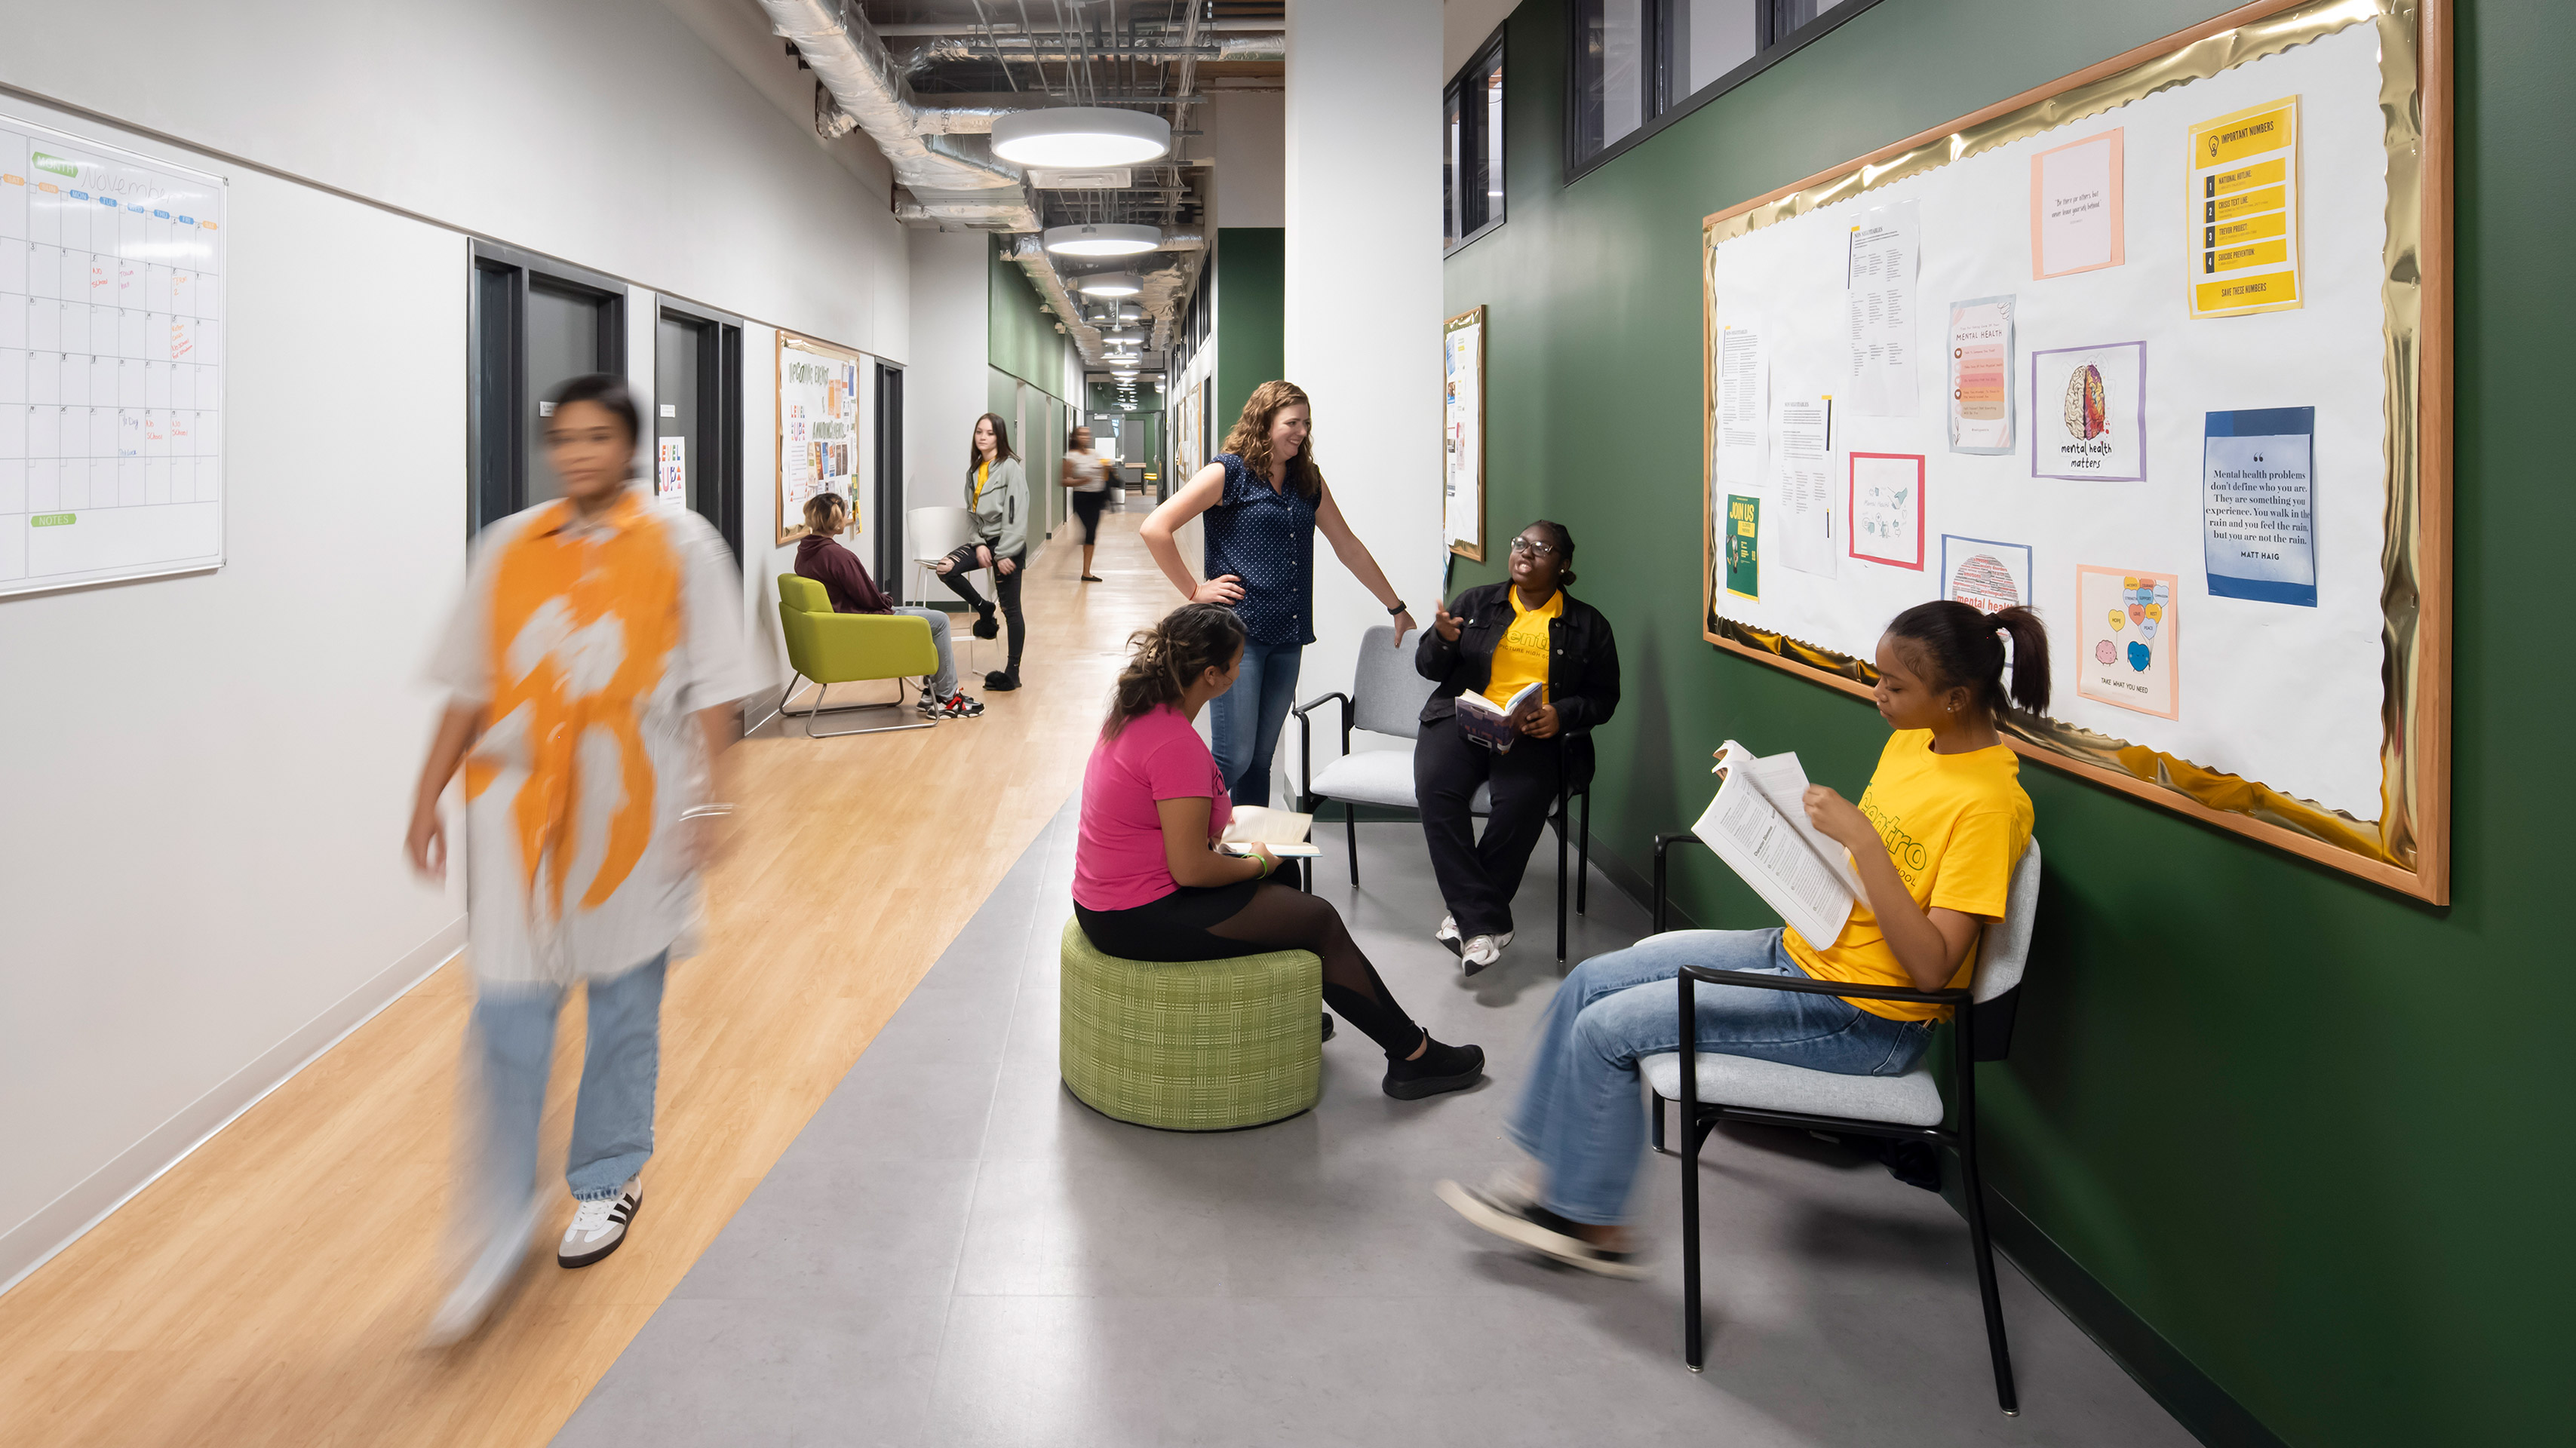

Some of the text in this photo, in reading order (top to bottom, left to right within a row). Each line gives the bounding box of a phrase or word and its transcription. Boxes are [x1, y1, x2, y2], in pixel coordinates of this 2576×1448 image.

[2221, 121, 2274, 144] IMPORTANT NUMBERS
[37, 155, 74, 174] MONTH
[2218, 174, 2237, 184] NATIONAL
[2209, 182, 2212, 191] 1
[72, 191, 87, 200] MON
[102, 198, 115, 206] TUE
[128, 204, 142, 213] WED
[156, 210, 167, 219] THU
[2218, 200, 2231, 209] CRISIS
[2231, 198, 2240, 206] TEXT
[2209, 207, 2212, 216] 2
[2219, 226, 2233, 235] TREVOR
[2209, 232, 2212, 241] 3
[2208, 257, 2212, 266] 4
[2218, 252, 2233, 261] SUICIDE
[2221, 282, 2267, 297] SAVE THESE NUMBERS
[1956, 330, 2003, 341] MENTAL HEALTH
[789, 361, 829, 387] UPCOMING EVENTS
[791, 405, 805, 419] LEVEL
[659, 444, 680, 462] EVEL
[2061, 440, 2112, 456] mental health
[2071, 457, 2101, 468] matters
[2214, 470, 2306, 480] Mental health problems
[2210, 482, 2231, 490] don't
[2233, 482, 2257, 491] define
[2259, 483, 2276, 492] who
[2277, 485, 2292, 493] you
[2214, 494, 2234, 505] They
[2249, 495, 2291, 506] something
[2292, 499, 2305, 507] you
[1730, 502, 1755, 522] JOIN US
[2206, 507, 2310, 519] experience. You walk in the
[39, 515, 69, 525] NOTES
[2209, 519, 2227, 527] rain
[2228, 519, 2243, 528] and
[2244, 522, 2258, 530] you
[2261, 520, 2275, 529] feel
[2277, 521, 2290, 531] the
[2213, 530, 2228, 539] but
[2228, 533, 2243, 541] you
[2274, 534, 2287, 543] the
[2289, 535, 2307, 545] rain.
[2261, 552, 2280, 560] HAIG
[1957, 596, 1985, 609] mental
[1498, 643, 1524, 654] PICTURE
[2101, 677, 2111, 686] TAKE
[2126, 683, 2135, 691] YOU
[2135, 686, 2148, 694] NEED
